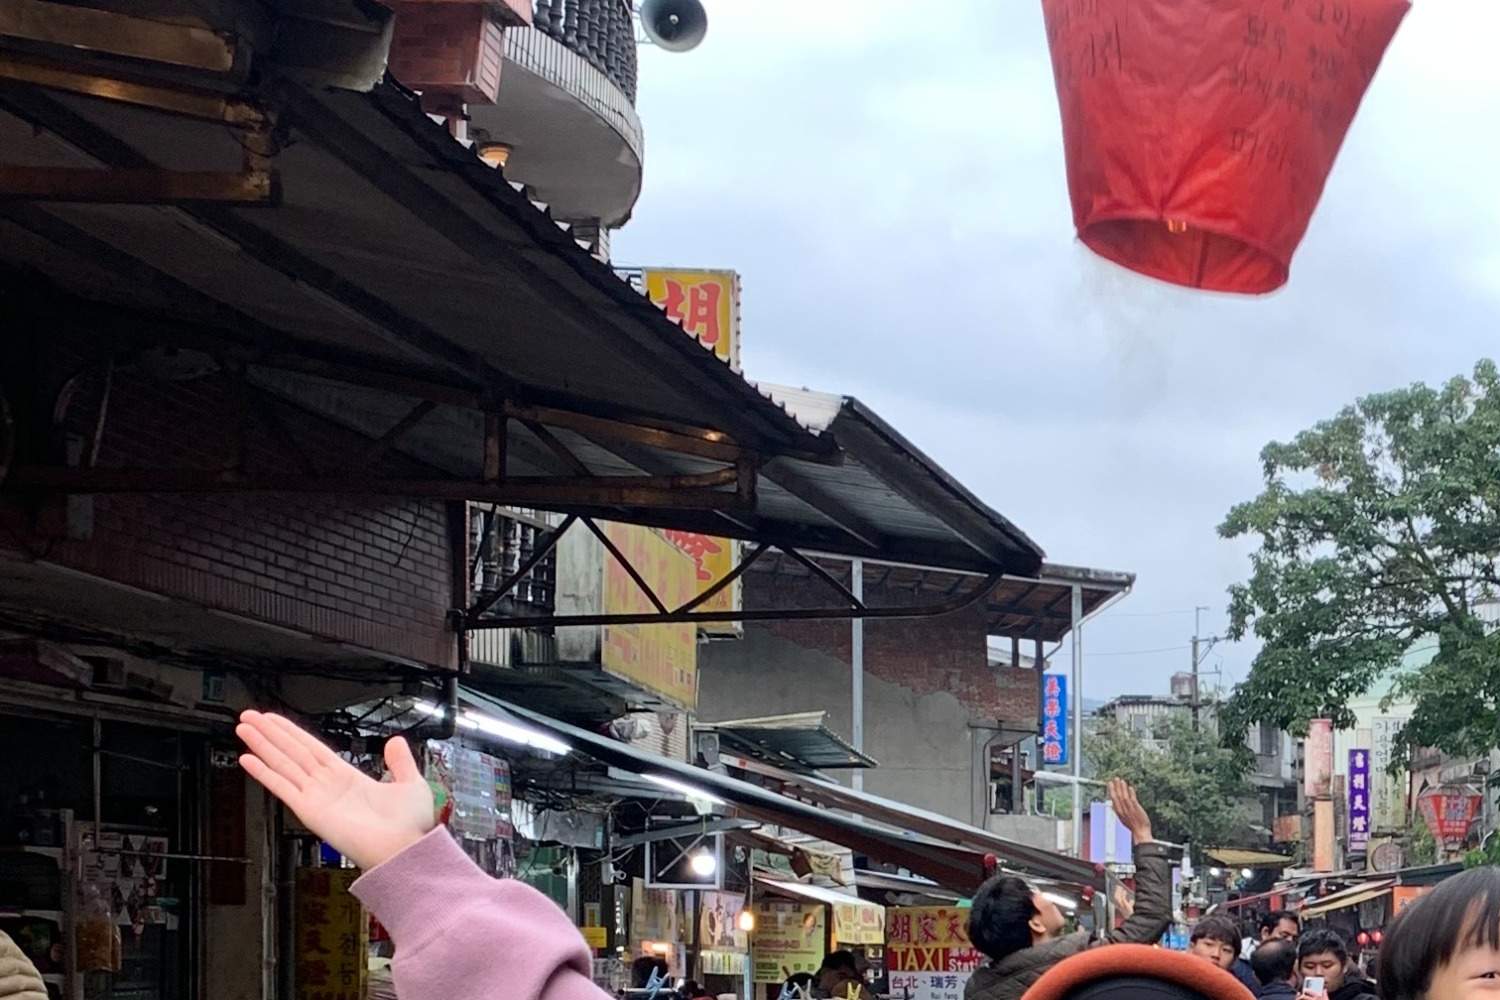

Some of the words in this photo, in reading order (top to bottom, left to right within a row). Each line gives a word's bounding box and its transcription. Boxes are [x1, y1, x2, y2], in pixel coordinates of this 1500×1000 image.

[889, 912, 969, 943] 胡家天
[892, 946, 945, 971] TAXI
